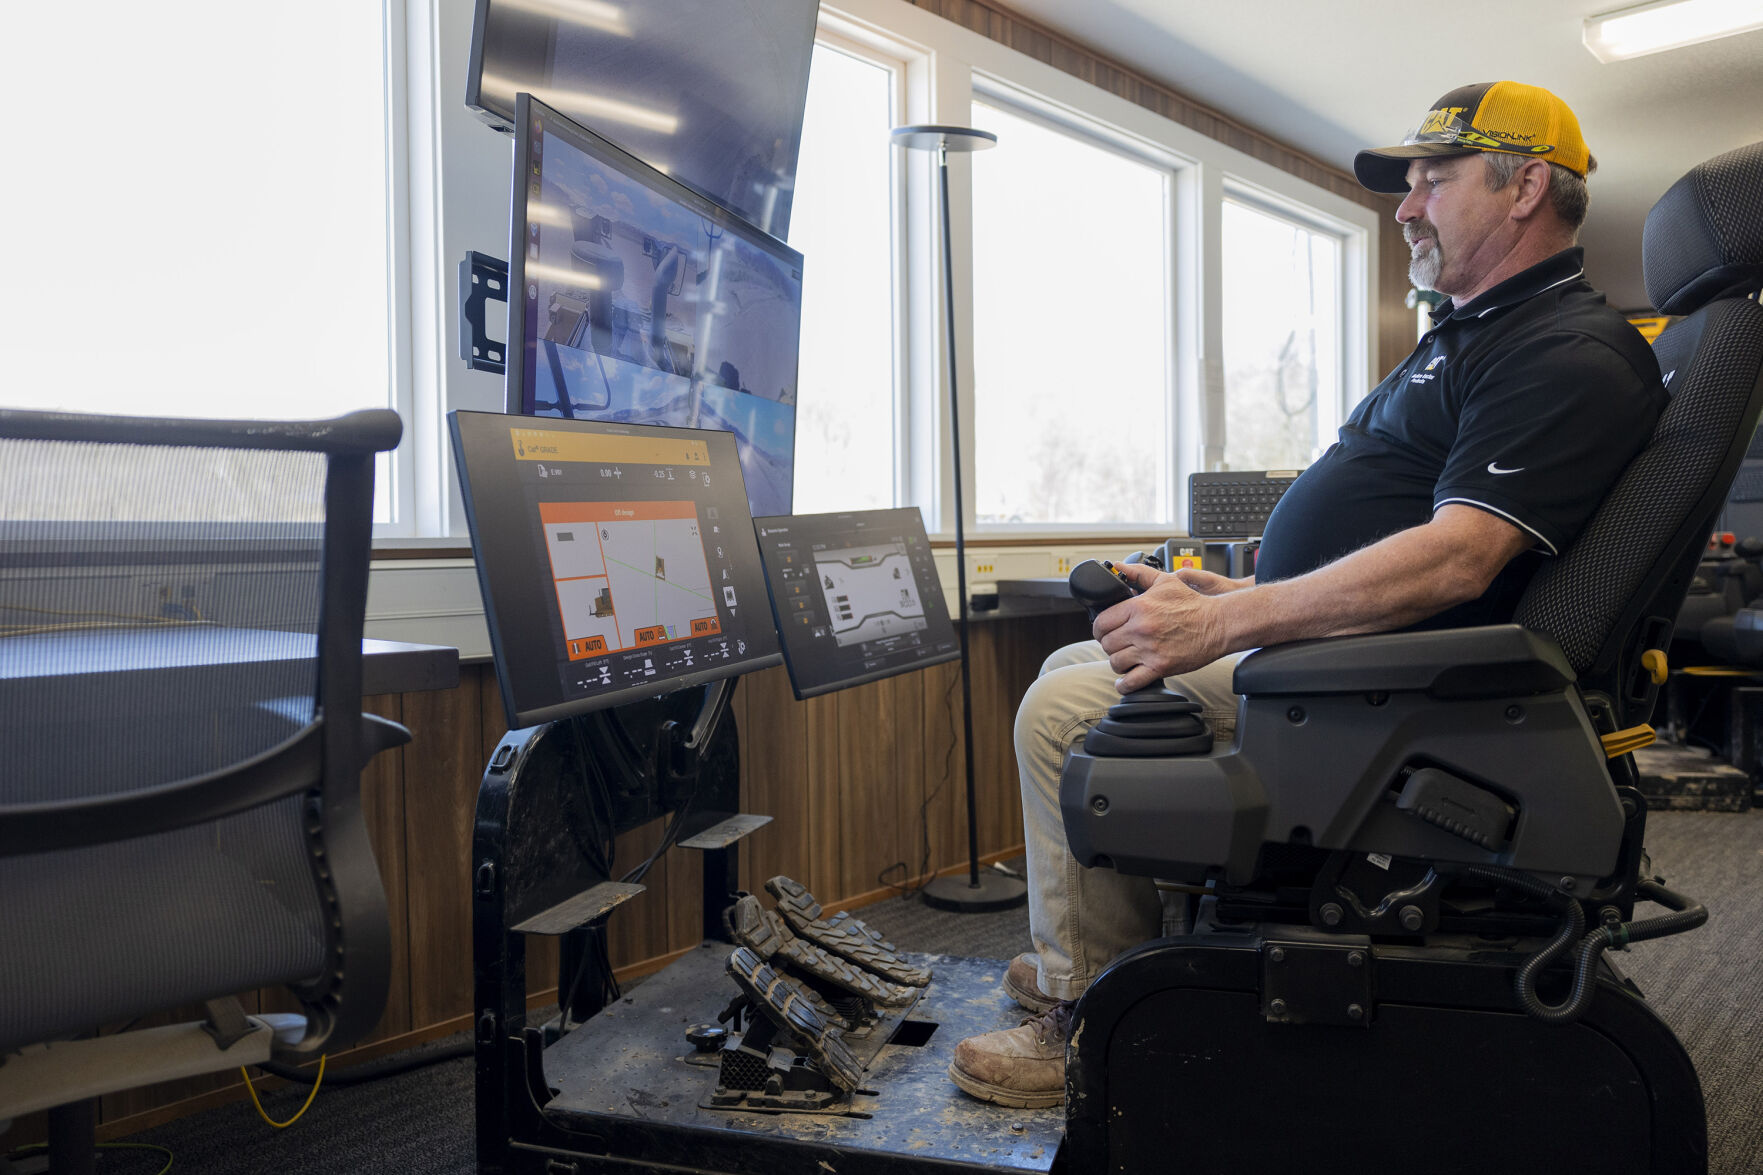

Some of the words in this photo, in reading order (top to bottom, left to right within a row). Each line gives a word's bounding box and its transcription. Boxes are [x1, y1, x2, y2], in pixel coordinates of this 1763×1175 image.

[1420, 107, 1463, 134] CAT
[1482, 129, 1532, 142] VISIONLINK
[694, 621, 708, 632] AUTO
[639, 630, 655, 641] AUTO
[585, 640, 602, 652] AUTO
